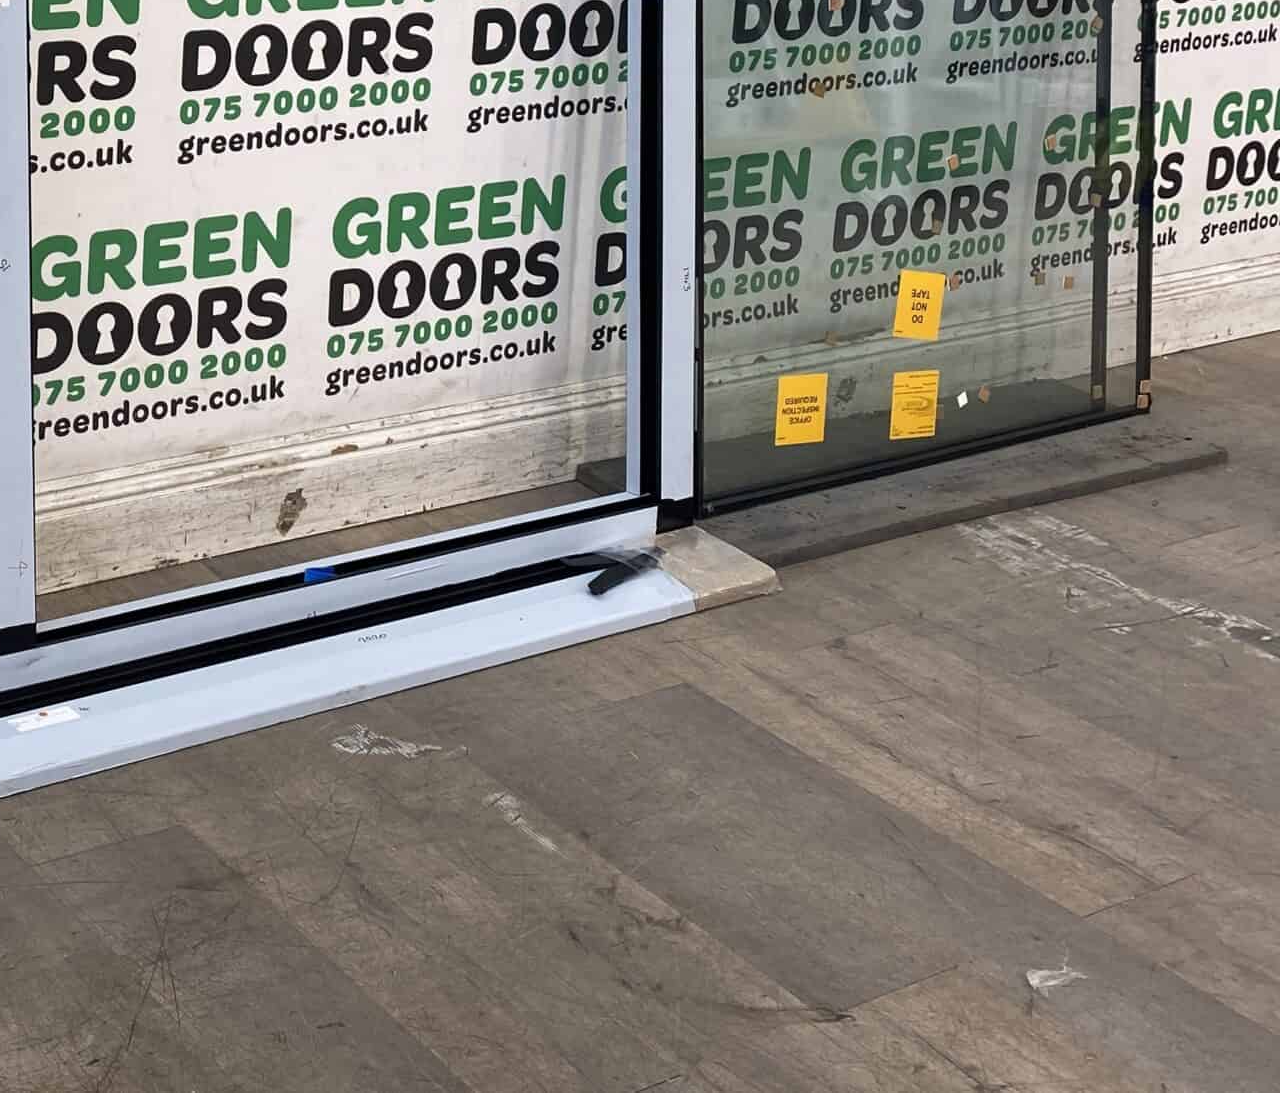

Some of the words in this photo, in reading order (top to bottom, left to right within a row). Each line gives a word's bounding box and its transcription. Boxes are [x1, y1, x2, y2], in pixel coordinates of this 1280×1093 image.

[1177, 5, 1226, 27] 7000
[1232, 0, 1280, 21] 2000
[181, 12, 434, 92] DOORS
[730, 49, 777, 73] 075
[786, 41, 850, 68] 7000
[858, 35, 921, 60] 2000
[950, 29, 991, 51] 075
[999, 22, 1055, 47] 7000
[468, 70, 524, 96] 075
[535, 62, 610, 90] 7000
[41, 106, 135, 138] 2000
[179, 96, 241, 124] 075
[254, 87, 338, 117] 7000
[350, 78, 430, 107] 2000
[177, 108, 427, 165] greendoors.co.uk
[840, 121, 1017, 193] GREEN
[332, 174, 565, 259] GREEN
[833, 179, 1010, 253] DOORS
[1203, 191, 1238, 216] 075
[1034, 222, 1070, 246] 075
[831, 254, 874, 279] 075
[883, 243, 941, 271] 7000
[948, 233, 1006, 260] 2000
[328, 240, 560, 328] DOORS
[734, 267, 802, 295] 2000
[912, 289, 930, 300] TAPE
[912, 302, 927, 312] NOT
[912, 314, 924, 324] DO
[327, 329, 383, 358] 075
[395, 315, 472, 348] 7000
[483, 302, 557, 333] 2000
[99, 360, 188, 396] 7000
[201, 344, 286, 379] 2000
[325, 331, 555, 396] greendoors.co.uk
